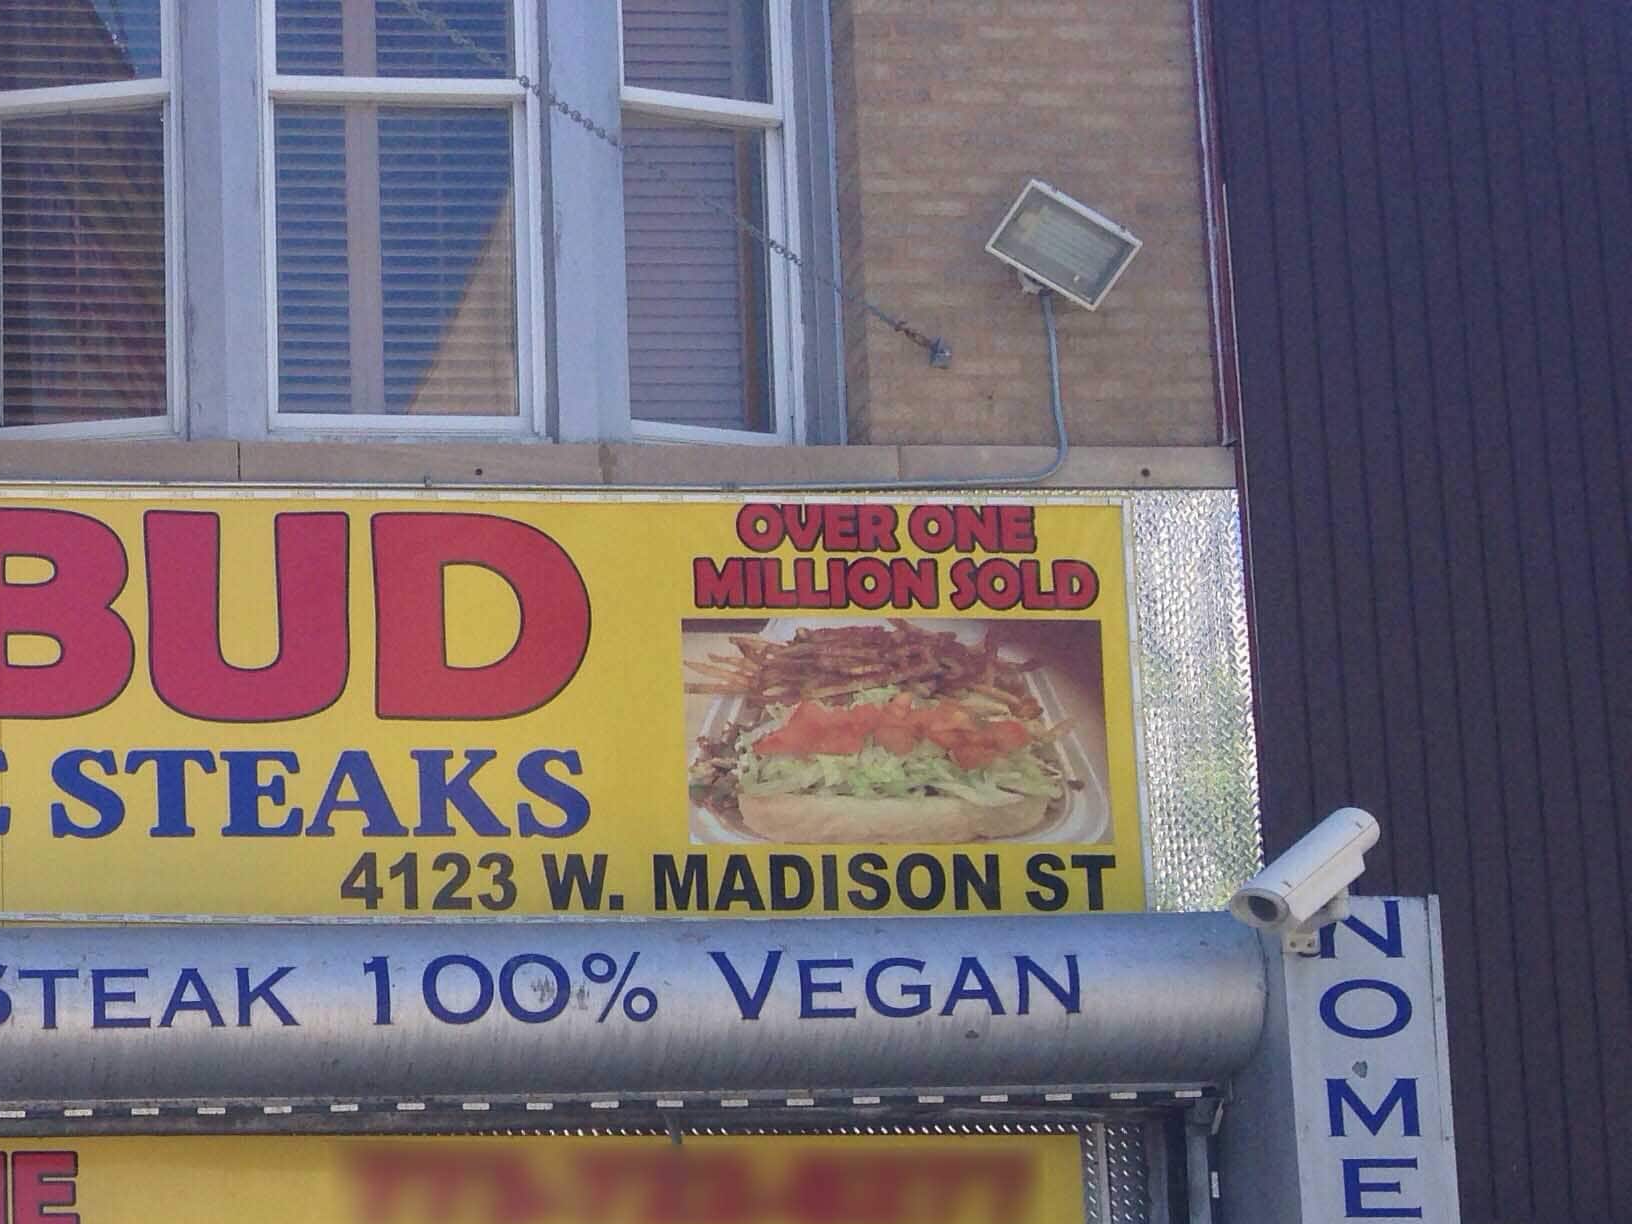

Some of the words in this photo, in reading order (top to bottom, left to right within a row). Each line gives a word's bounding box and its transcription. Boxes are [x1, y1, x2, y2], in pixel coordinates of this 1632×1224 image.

[735, 503, 901, 552] OVER
[908, 504, 1037, 554] ONE
[693, 557, 938, 610] MILLION
[950, 558, 1100, 611] SOLD
[51, 749, 592, 839] STEAKS
[340, 852, 519, 911] 4123
[543, 853, 629, 912] W.
[653, 853, 1014, 912] MADISON
[1024, 853, 1116, 912] ST
[363, 951, 659, 1026] 100%
[708, 950, 1083, 1021] VEGAN
